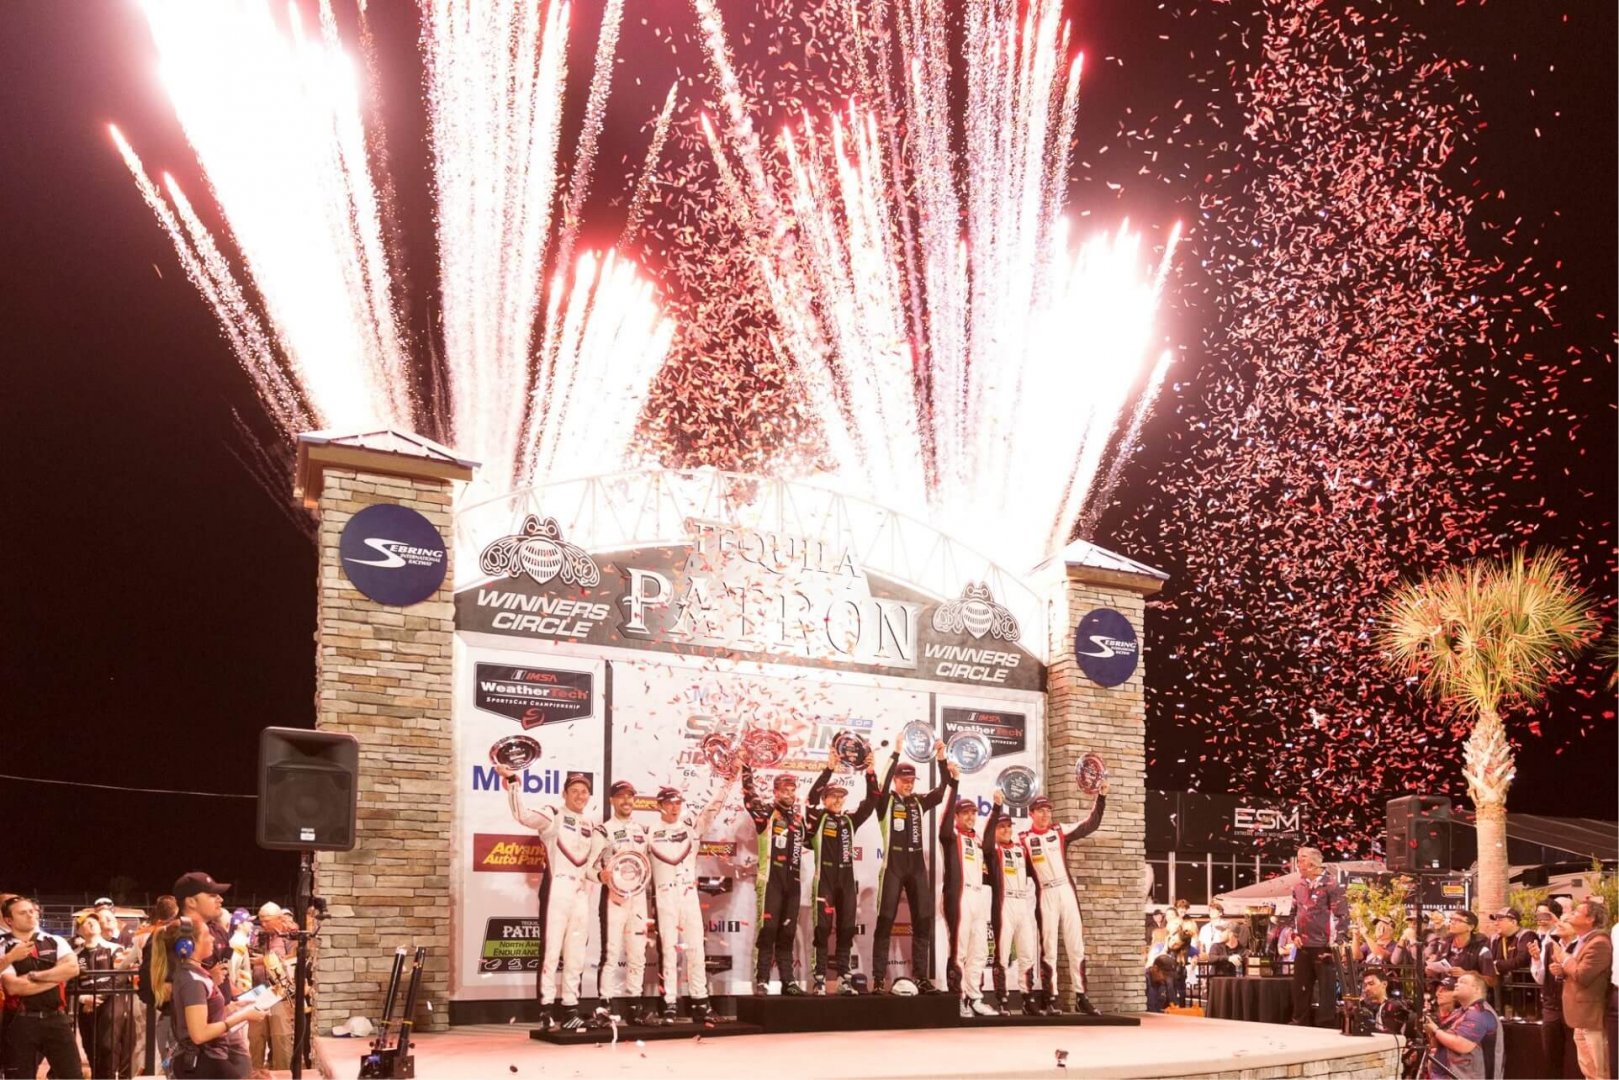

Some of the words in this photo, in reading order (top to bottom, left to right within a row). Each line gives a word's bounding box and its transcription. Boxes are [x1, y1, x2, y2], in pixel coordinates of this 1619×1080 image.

[344, 538, 443, 568] SEBRING
[477, 589, 610, 620] WINNERS
[491, 612, 593, 638] CIRCLE
[924, 643, 1021, 668] WINNERS
[1078, 636, 1137, 658] SEBRING
[526, 672, 557, 682] IMSA
[936, 662, 1009, 683] CIRCLE
[480, 681, 588, 700] WeatherTech
[1234, 808, 1299, 830] ESM
[482, 854, 517, 865] Auto
[503, 925, 540, 938] PATR
